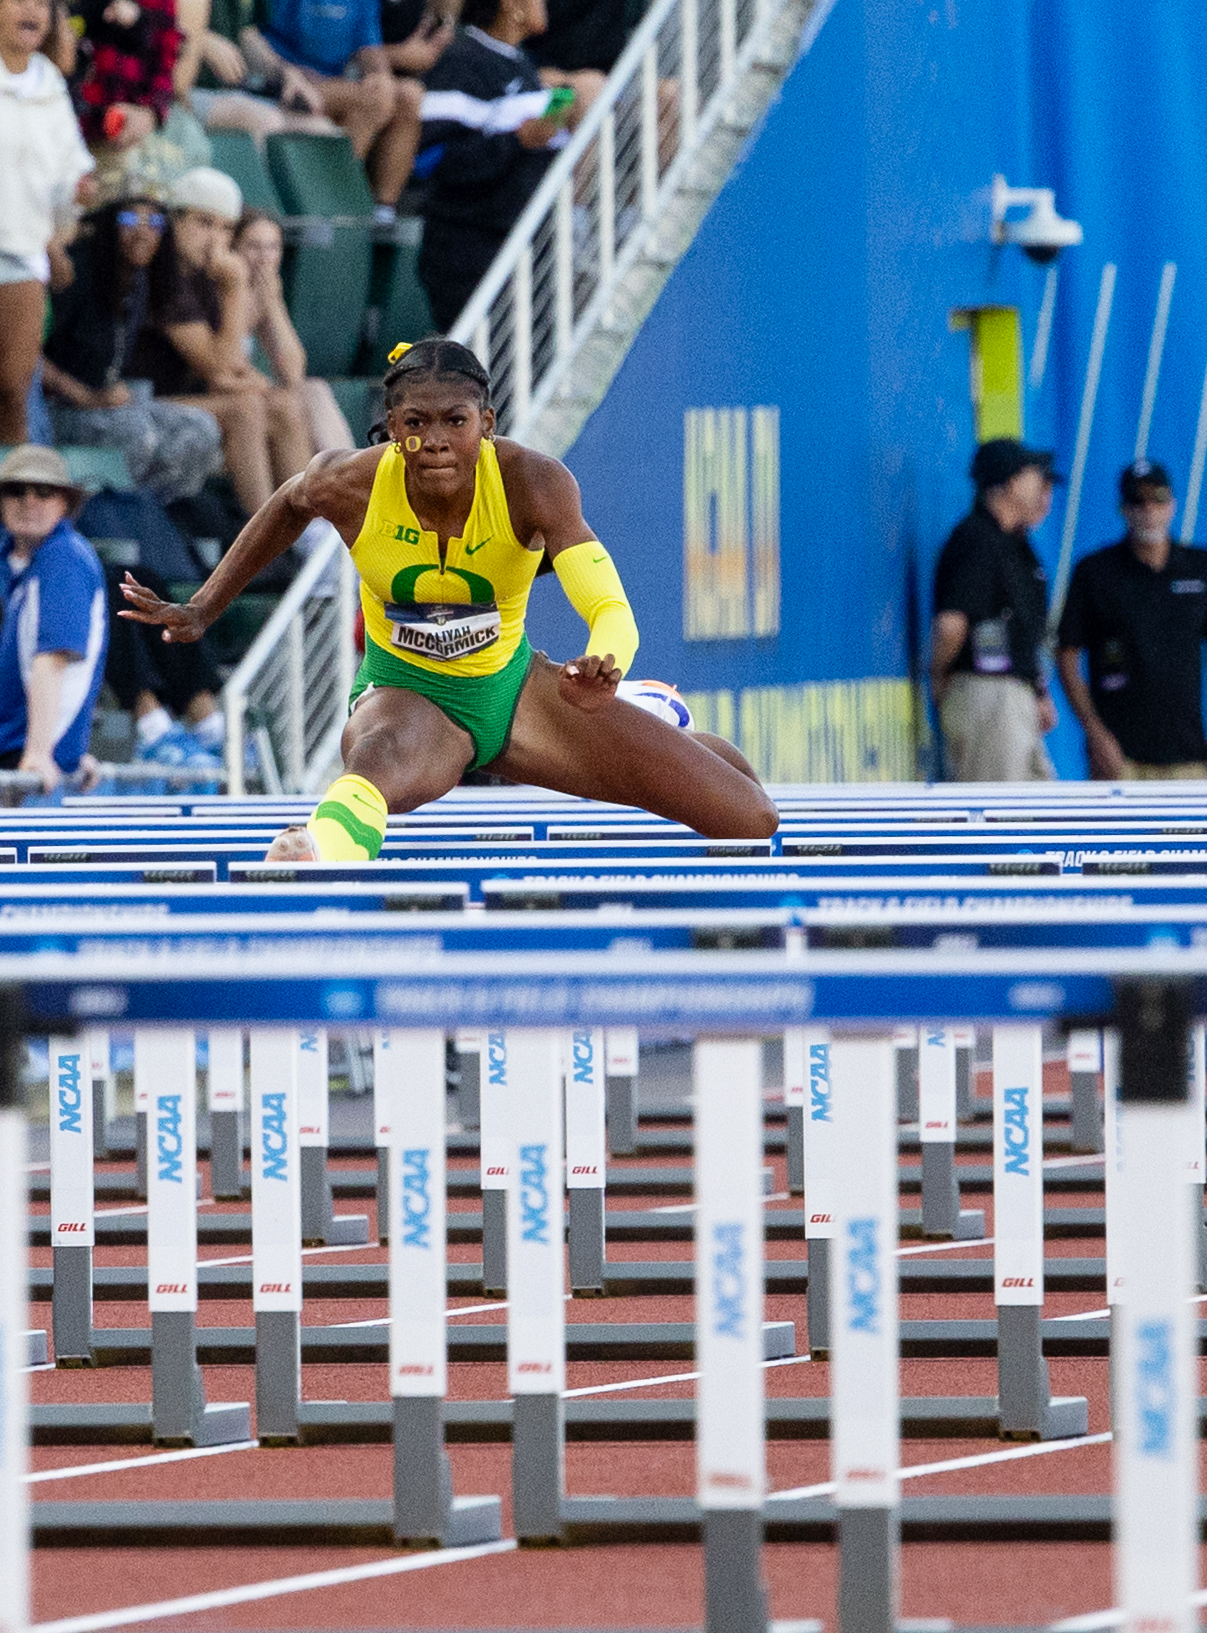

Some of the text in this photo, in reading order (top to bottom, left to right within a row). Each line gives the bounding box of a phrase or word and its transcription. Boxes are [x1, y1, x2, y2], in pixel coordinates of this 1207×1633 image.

[488, 1028, 507, 1086] NCA
[572, 1029, 594, 1085] NCA
[810, 1043, 831, 1122] NCAA
[58, 1054, 83, 1134] NCAA
[157, 1094, 183, 1184] NCAA
[262, 1092, 289, 1182] NCAA
[1004, 1087, 1030, 1177] NCAA
[402, 1148, 432, 1250] NCAA
[487, 1167, 509, 1176] GIL
[519, 1144, 550, 1245] NCAA
[572, 1166, 598, 1175] GILL
[58, 1222, 86, 1233] GILL
[810, 1213, 834, 1224] GIL
[156, 1283, 188, 1294] GILL
[260, 1283, 292, 1294] GILL
[1001, 1277, 1034, 1288] GILL
